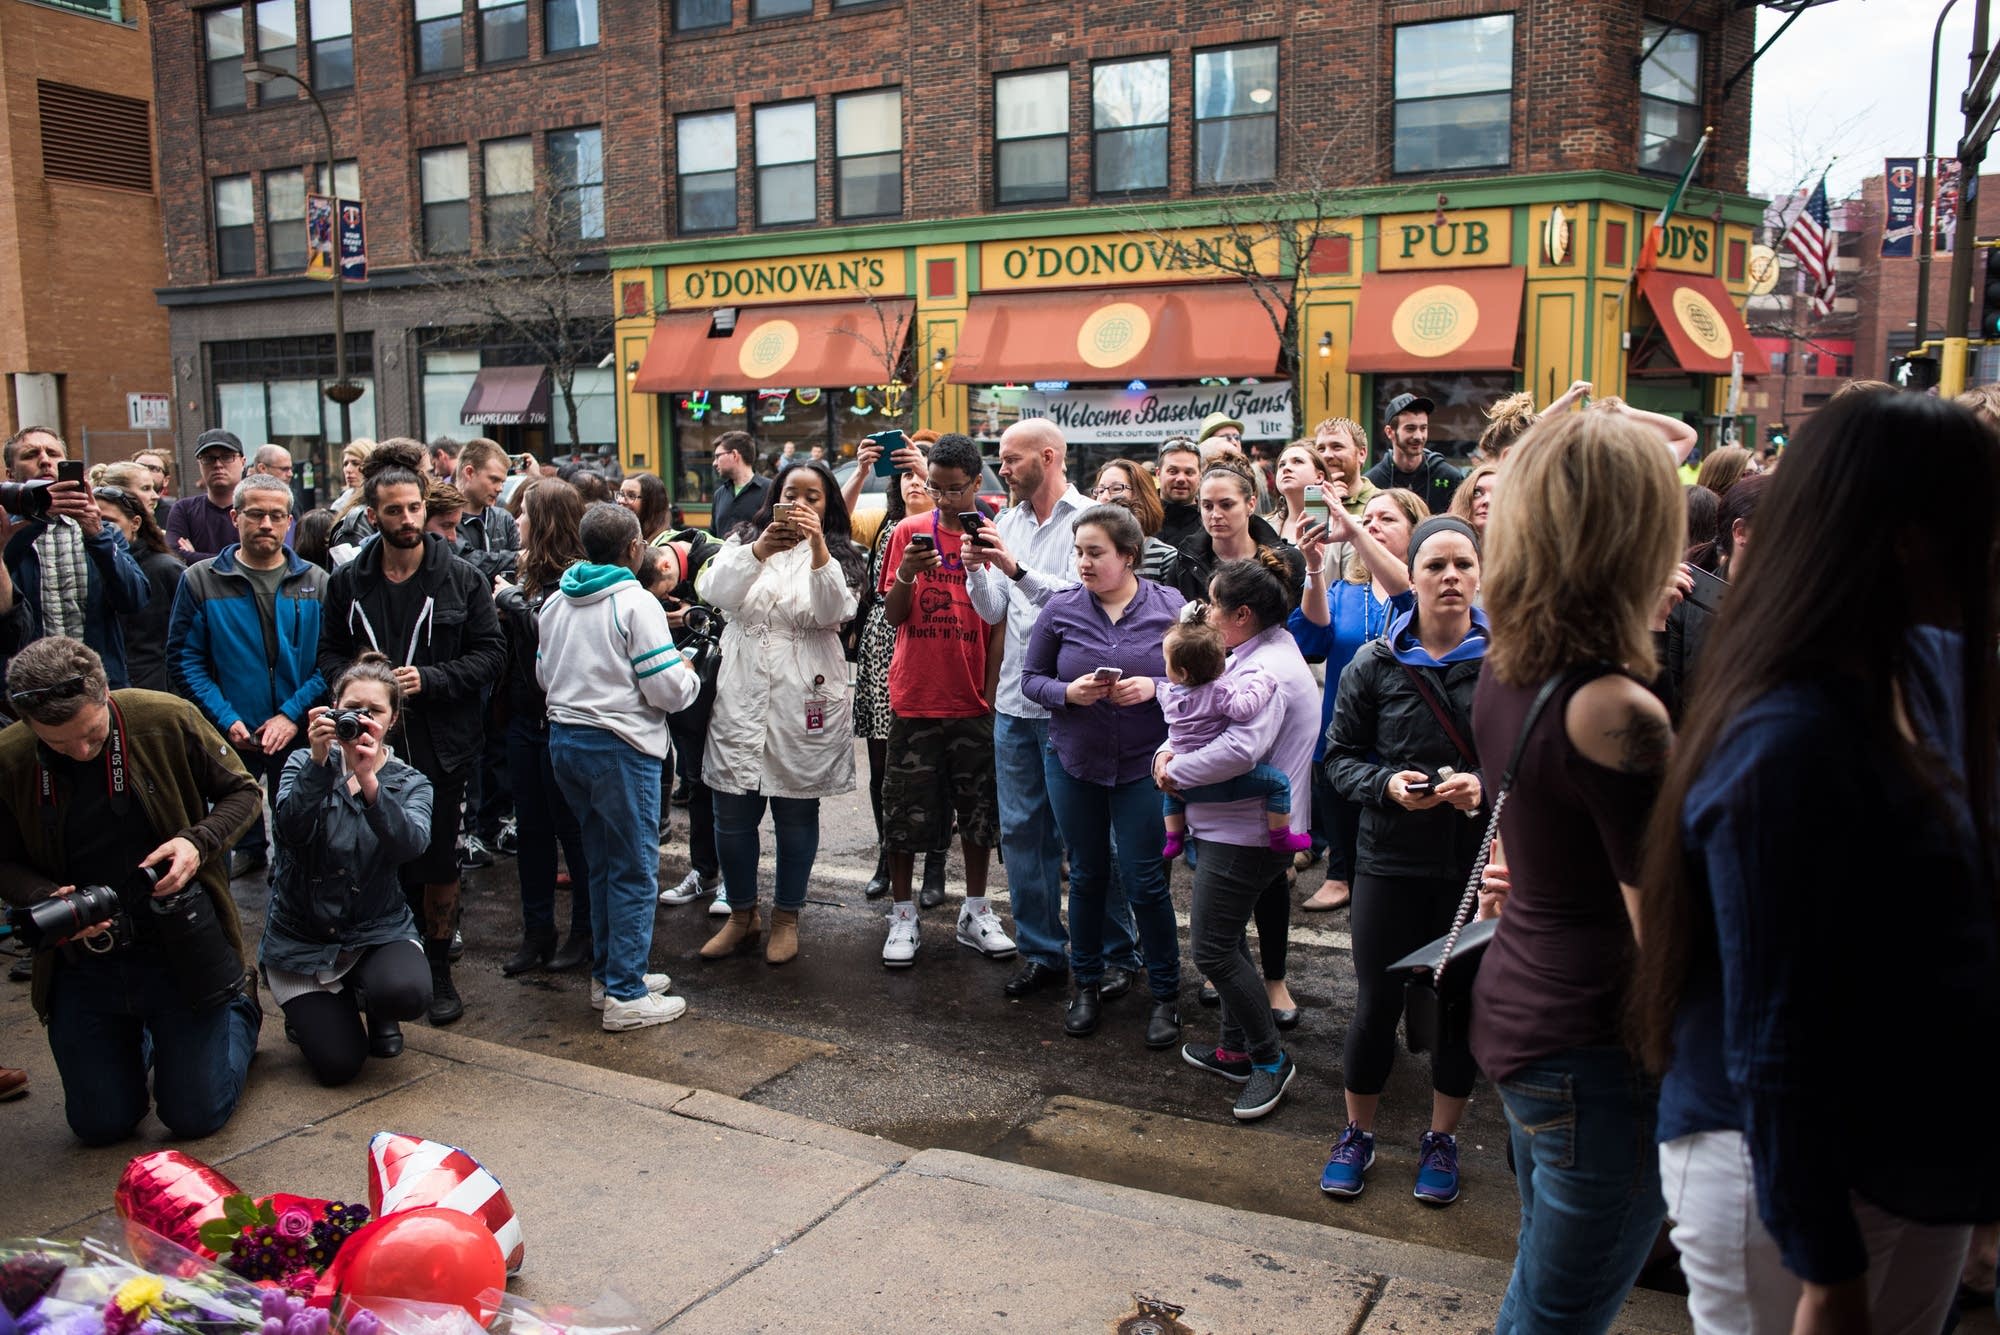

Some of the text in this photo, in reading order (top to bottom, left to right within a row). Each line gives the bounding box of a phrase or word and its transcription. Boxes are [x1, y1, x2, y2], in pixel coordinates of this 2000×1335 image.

[1399, 221, 1489, 258] PUB
[1003, 234, 1253, 280] O'DONOVAN'S
[684, 256, 885, 300] O'DONOVAN'S
[464, 412, 547, 426] LAMOREAUX 706
[1049, 388, 1293, 429] Welcome Baseball Fans!
[1096, 429, 1124, 438] CHECK
[1126, 429, 1143, 438] OUT
[1145, 429, 1164, 437] OUR
[112, 753, 122, 766] 5D
[114, 767, 124, 792] EOS
